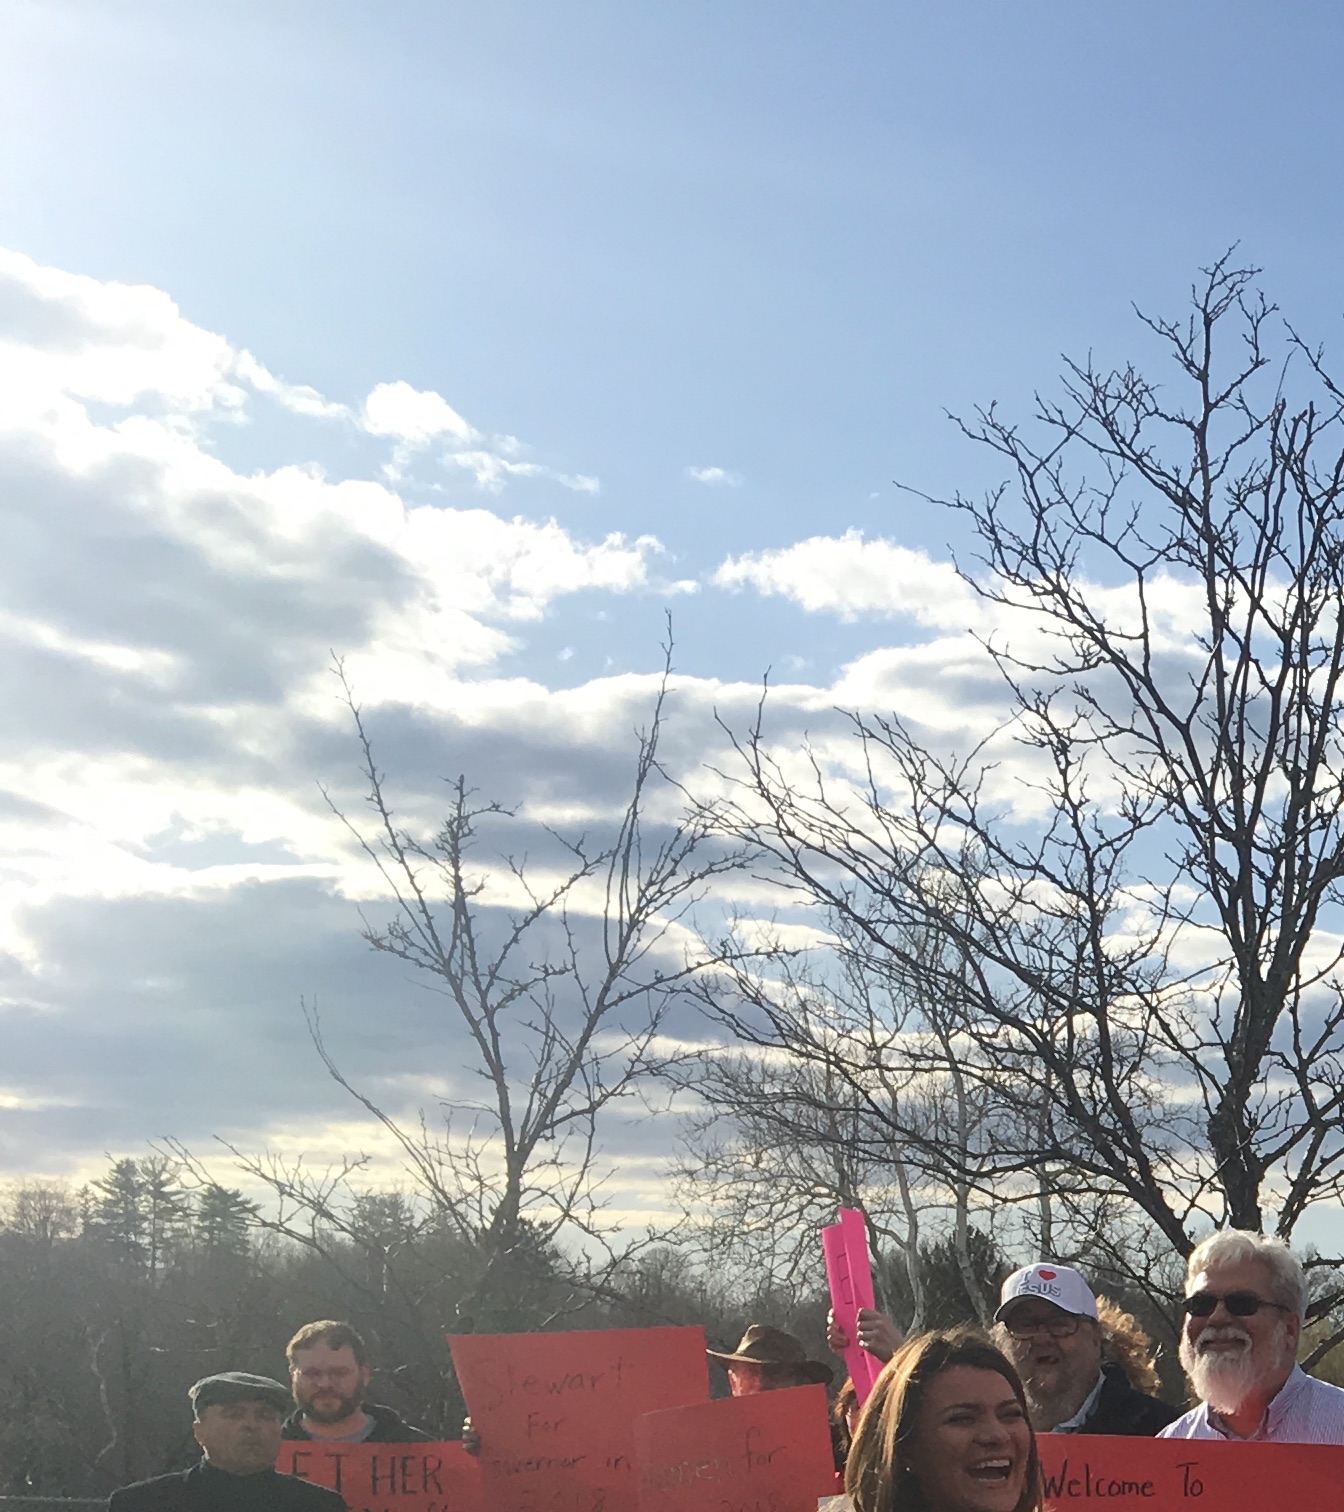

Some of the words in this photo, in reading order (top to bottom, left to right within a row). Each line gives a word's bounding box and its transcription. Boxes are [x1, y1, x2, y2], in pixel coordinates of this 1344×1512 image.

[291, 1451, 349, 1494] ET
[371, 1455, 444, 1496] HER
[1043, 1459, 1156, 1499] Welcome
[1176, 1461, 1204, 1498] To
